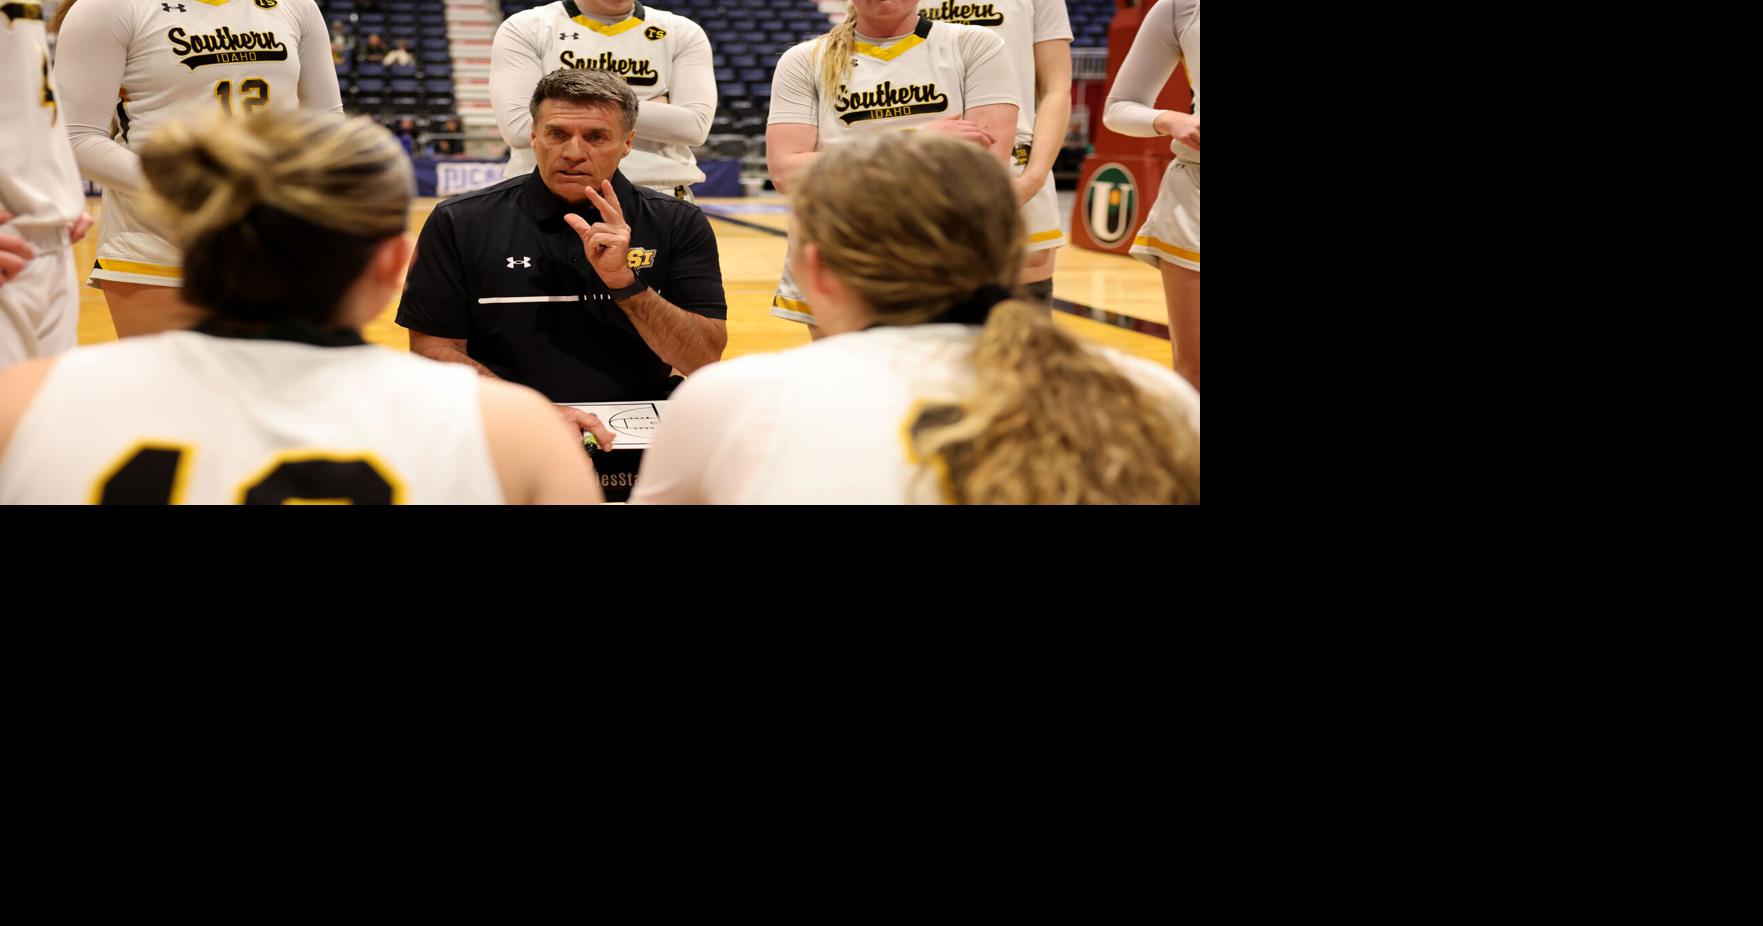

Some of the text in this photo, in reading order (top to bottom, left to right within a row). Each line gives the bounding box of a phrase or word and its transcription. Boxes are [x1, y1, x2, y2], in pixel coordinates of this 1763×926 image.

[918, 0, 994, 20] outhern
[168, 26, 279, 56] Southern
[648, 28, 664, 39] TS
[216, 51, 257, 63] IDAHO
[214, 78, 271, 119] 12
[871, 106, 911, 119] IDAHO
